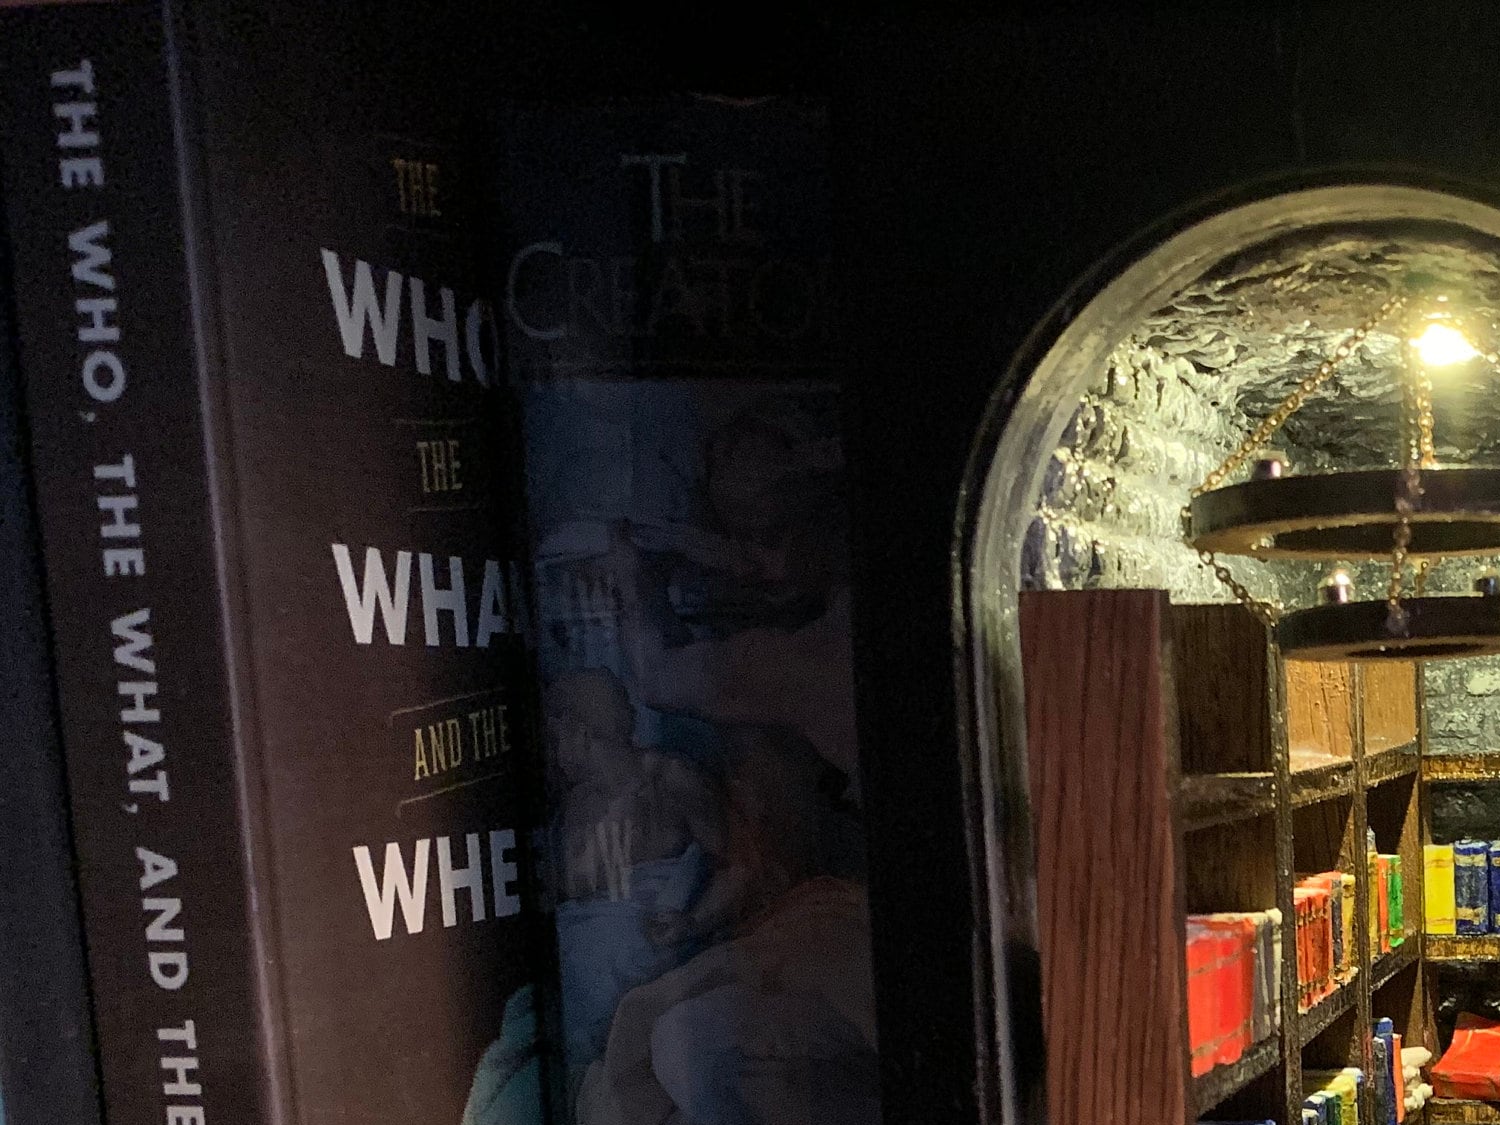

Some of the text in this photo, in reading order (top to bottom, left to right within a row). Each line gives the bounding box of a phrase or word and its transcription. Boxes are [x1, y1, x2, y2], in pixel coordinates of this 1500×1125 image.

[51, 59, 104, 188] THE
[394, 158, 441, 216] THE
[620, 152, 764, 242] THE
[68, 220, 126, 422] WHO,
[505, 241, 830, 340] CREATO
[94, 454, 144, 577] THE
[416, 440, 463, 492] THE
[331, 543, 518, 648] WHA
[111, 608, 170, 814] WHAT,
[414, 705, 512, 781] AND THE
[136, 846, 190, 989] AND
[353, 829, 520, 940] WHE
